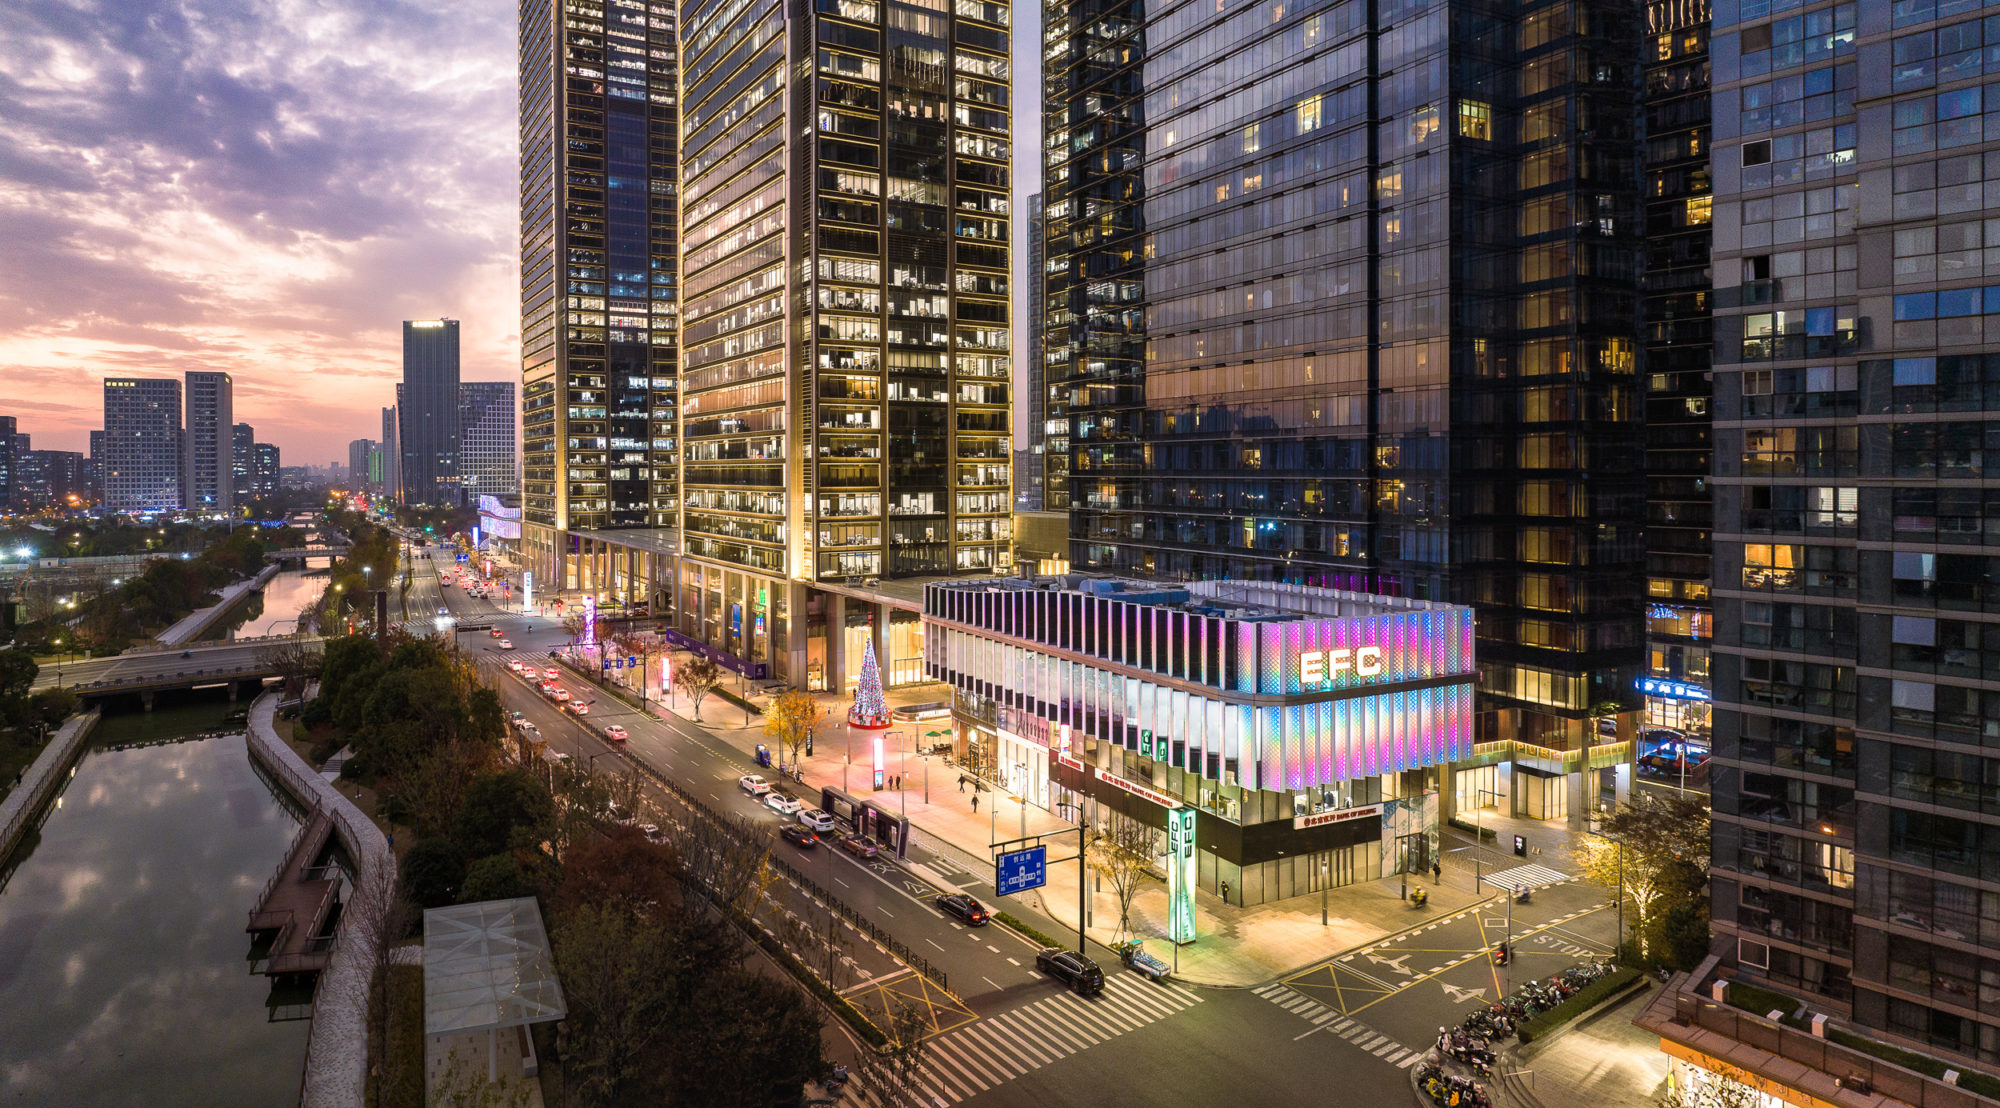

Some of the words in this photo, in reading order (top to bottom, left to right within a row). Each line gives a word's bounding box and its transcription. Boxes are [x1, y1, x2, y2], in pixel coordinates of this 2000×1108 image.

[1299, 646, 1381, 684] EFC
[1171, 821, 1179, 852] EFC
[1184, 816, 1192, 858] EFC
[1532, 935, 1596, 958] STOP
